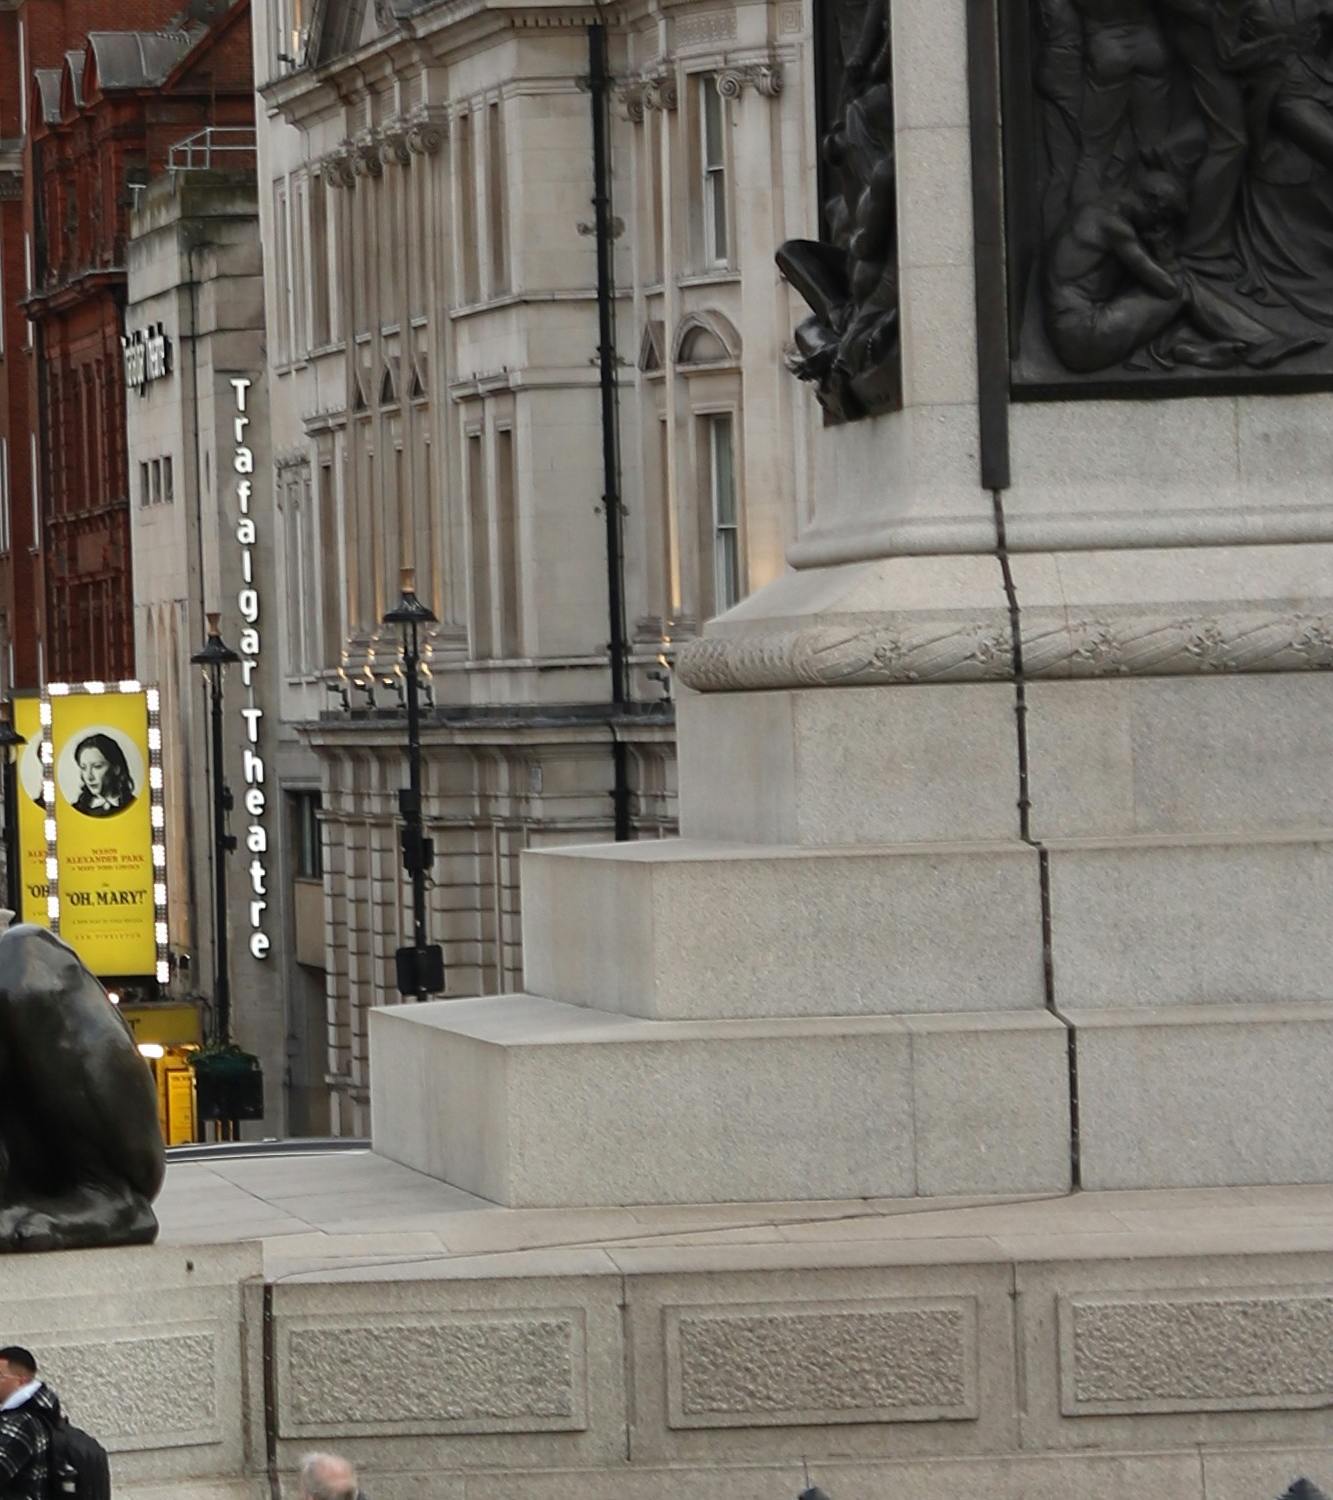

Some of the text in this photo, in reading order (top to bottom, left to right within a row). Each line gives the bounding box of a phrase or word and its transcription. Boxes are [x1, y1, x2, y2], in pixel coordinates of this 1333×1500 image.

[230, 378, 271, 959] Trafalgar Theatre
[121, 854, 145, 863] PARK
